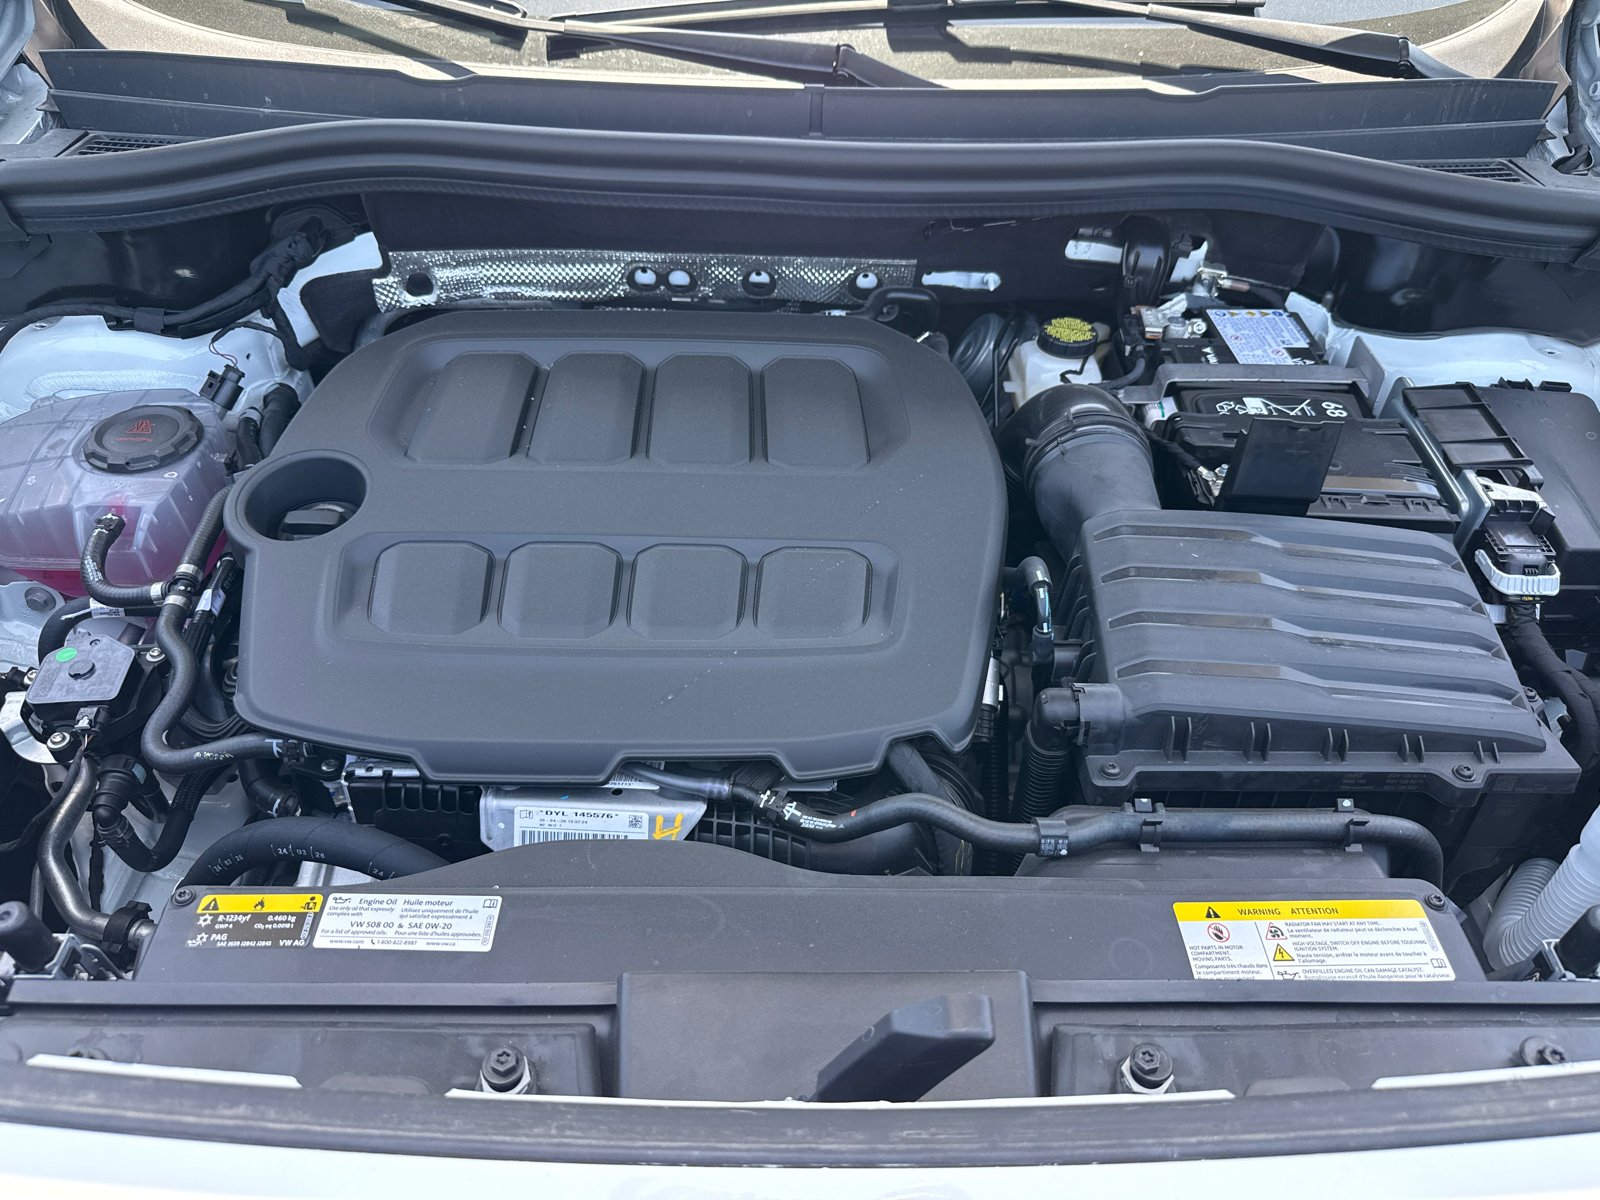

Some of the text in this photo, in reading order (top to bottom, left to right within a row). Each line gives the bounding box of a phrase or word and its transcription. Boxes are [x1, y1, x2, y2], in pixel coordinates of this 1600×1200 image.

[1322, 402, 1348, 417] 68
[359, 898, 384, 906] Engine
[217, 914, 251, 923] R-1234yf
[287, 915, 296, 923] kg
